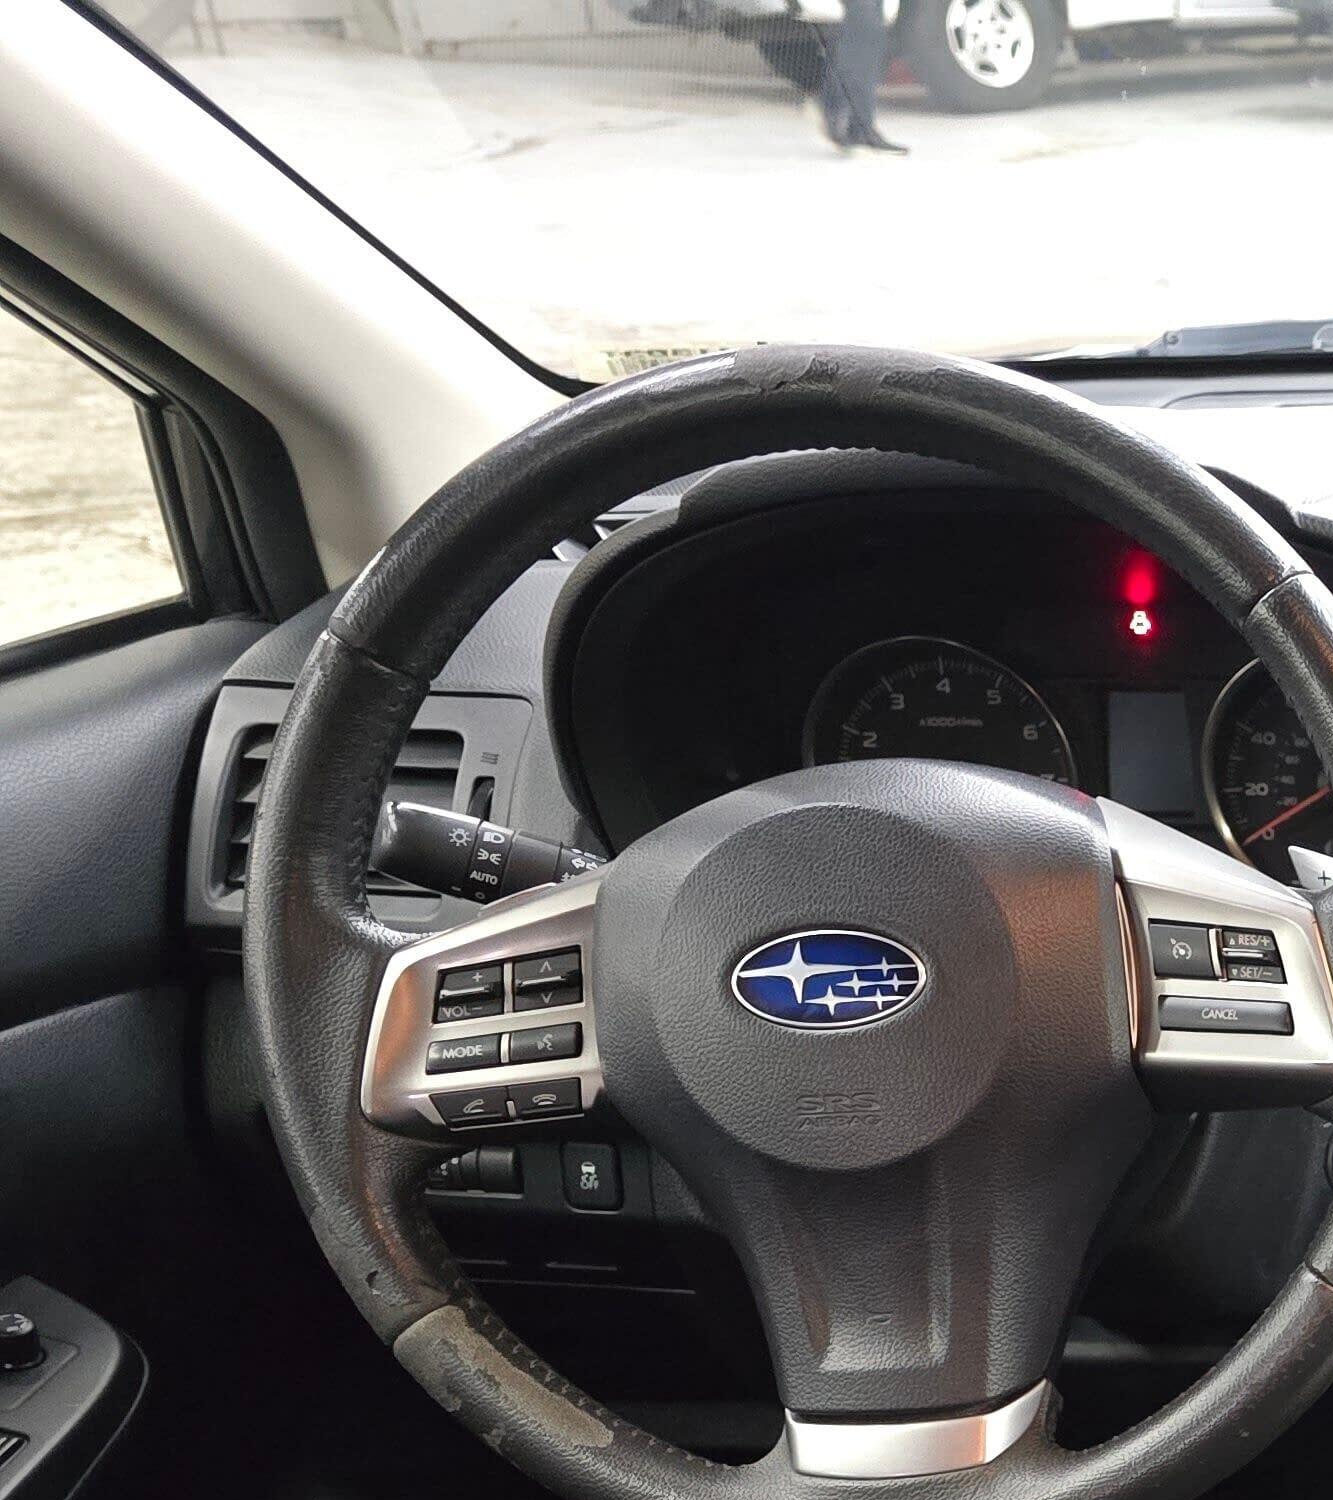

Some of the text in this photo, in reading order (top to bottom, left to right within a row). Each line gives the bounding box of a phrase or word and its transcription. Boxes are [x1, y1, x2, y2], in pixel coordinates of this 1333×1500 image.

[936, 677, 950, 693] 4
[890, 693, 905, 709] 3
[986, 689, 1001, 705] 5
[862, 731, 877, 748] 2
[1023, 723, 1038, 741] 6
[1245, 782, 1269, 797] 20
[470, 870, 498, 885] AUTO
[1201, 1007, 1238, 1021] CANCEL
[442, 1045, 483, 1060] MODE
